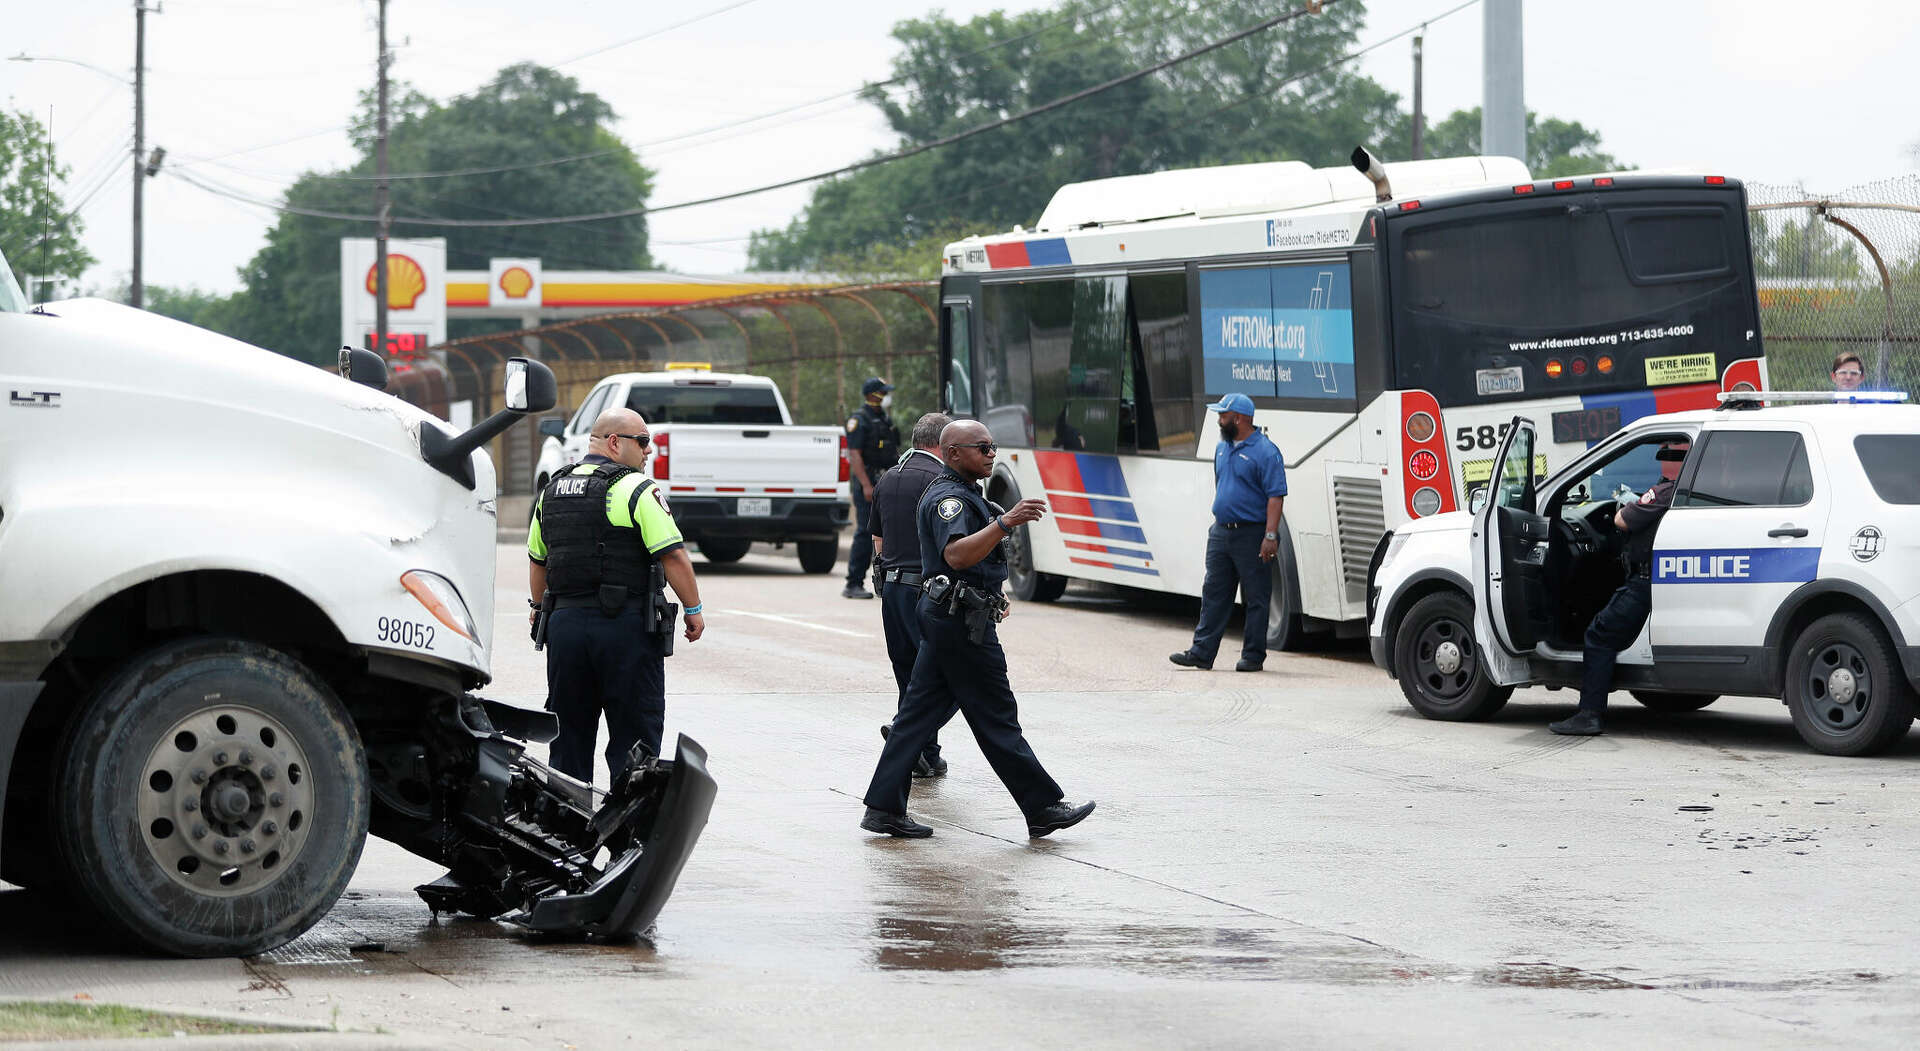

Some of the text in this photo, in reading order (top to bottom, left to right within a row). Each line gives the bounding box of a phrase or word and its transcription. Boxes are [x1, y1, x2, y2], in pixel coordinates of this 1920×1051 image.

[1276, 229, 1350, 247] Facebook.com/RideMETRO
[964, 249, 985, 264] METRO
[1221, 315, 1305, 359] METRONext.org
[1509, 325, 1694, 352] www.ridemetro.org 713-635-4000
[1746, 330, 1754, 341] P
[1650, 356, 1711, 370] WE'RE HIRING
[1232, 363, 1244, 379] Find
[1244, 364, 1256, 380] Out
[1277, 366, 1292, 382] Next
[11, 391, 61, 402] LT
[1559, 408, 1619, 440] STOP
[555, 478, 586, 495] POLICE
[1848, 535, 1887, 552] 911
[1659, 555, 1751, 579] POLICE
[378, 616, 435, 650] 98052
